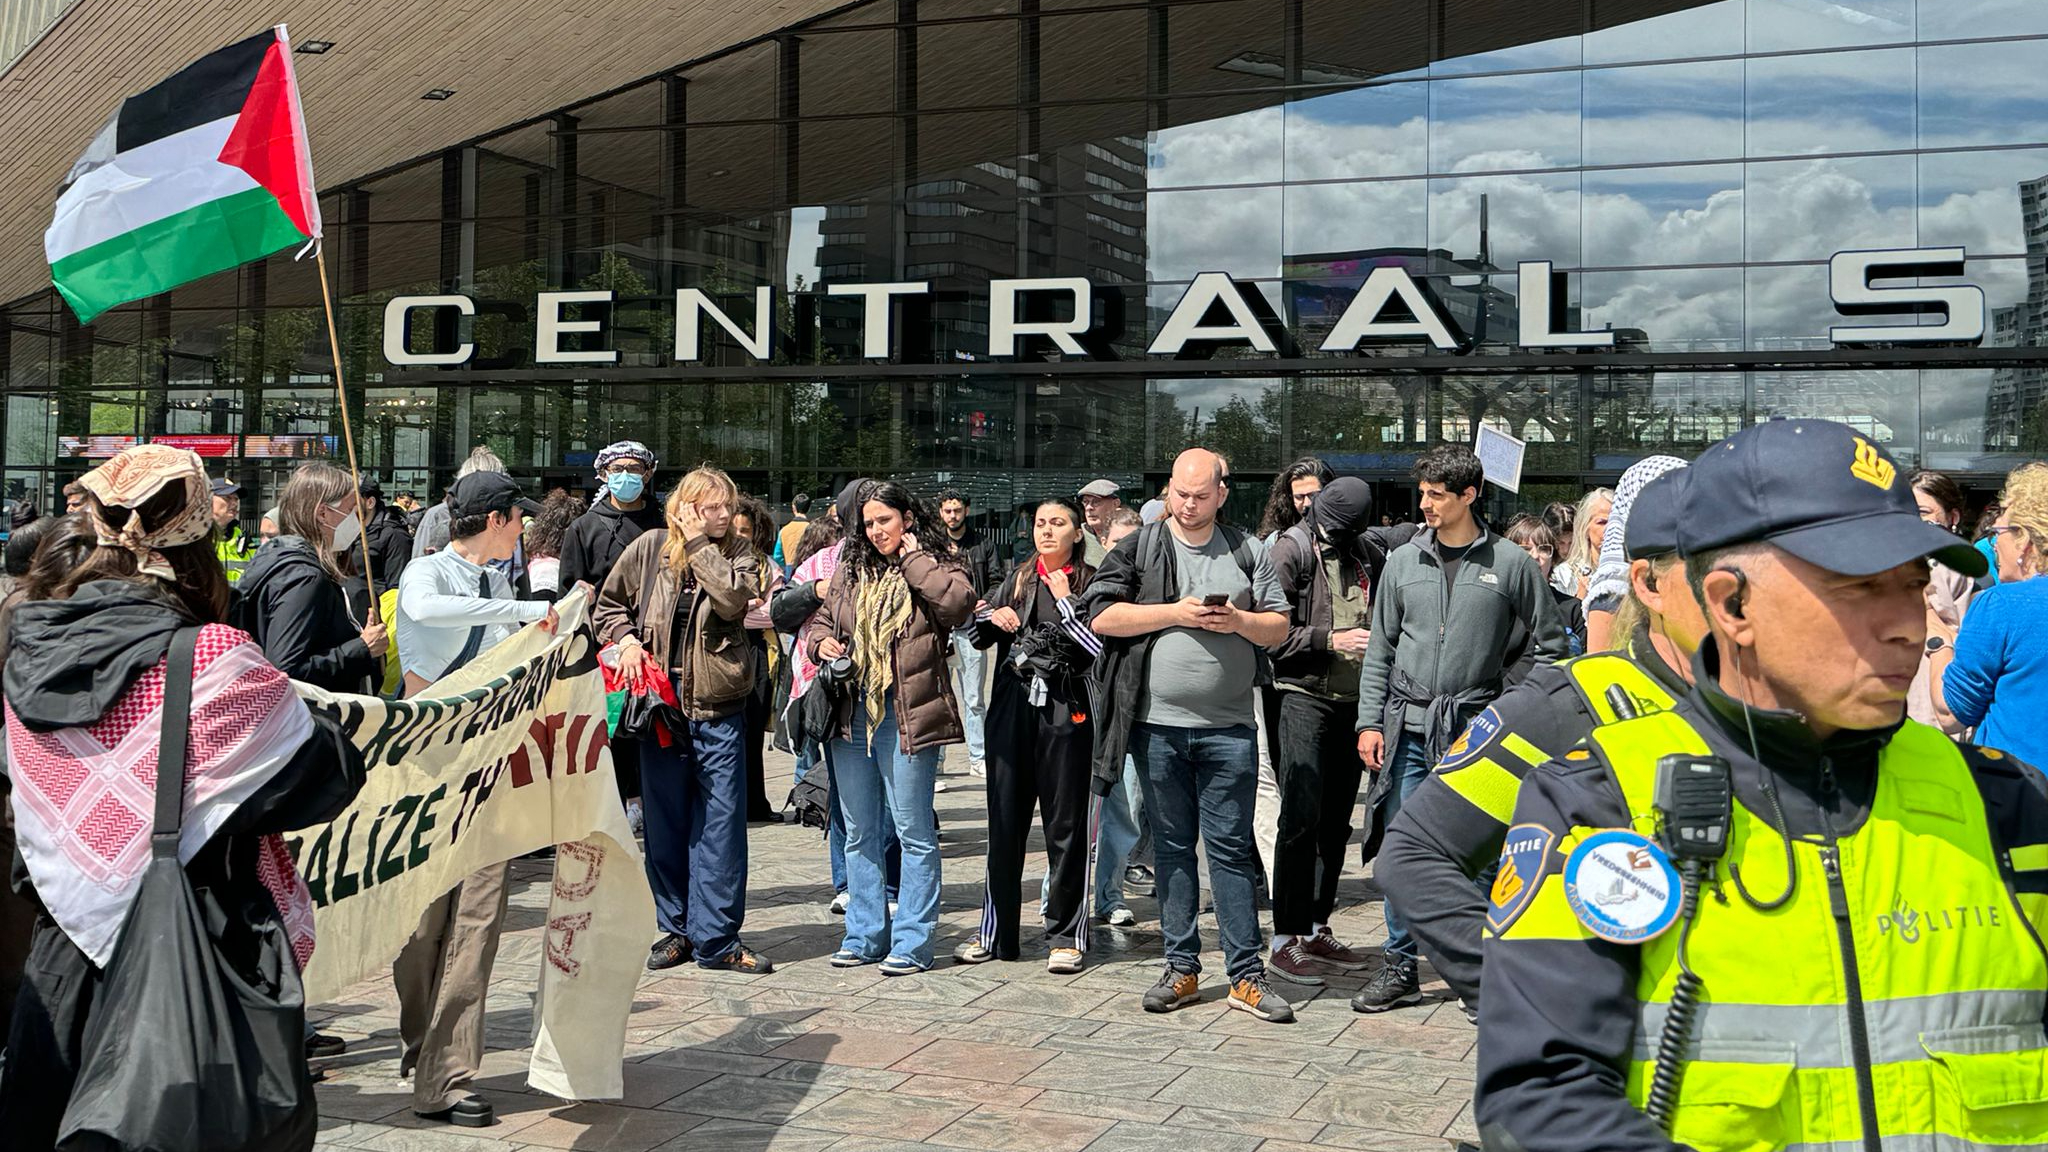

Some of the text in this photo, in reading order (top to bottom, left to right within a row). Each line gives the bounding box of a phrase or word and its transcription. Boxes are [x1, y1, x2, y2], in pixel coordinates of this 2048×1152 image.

[383, 246, 1986, 366] CENTRAAL S
[1505, 837, 1543, 856] LITIE
[1876, 903, 2002, 944] POLITIE
